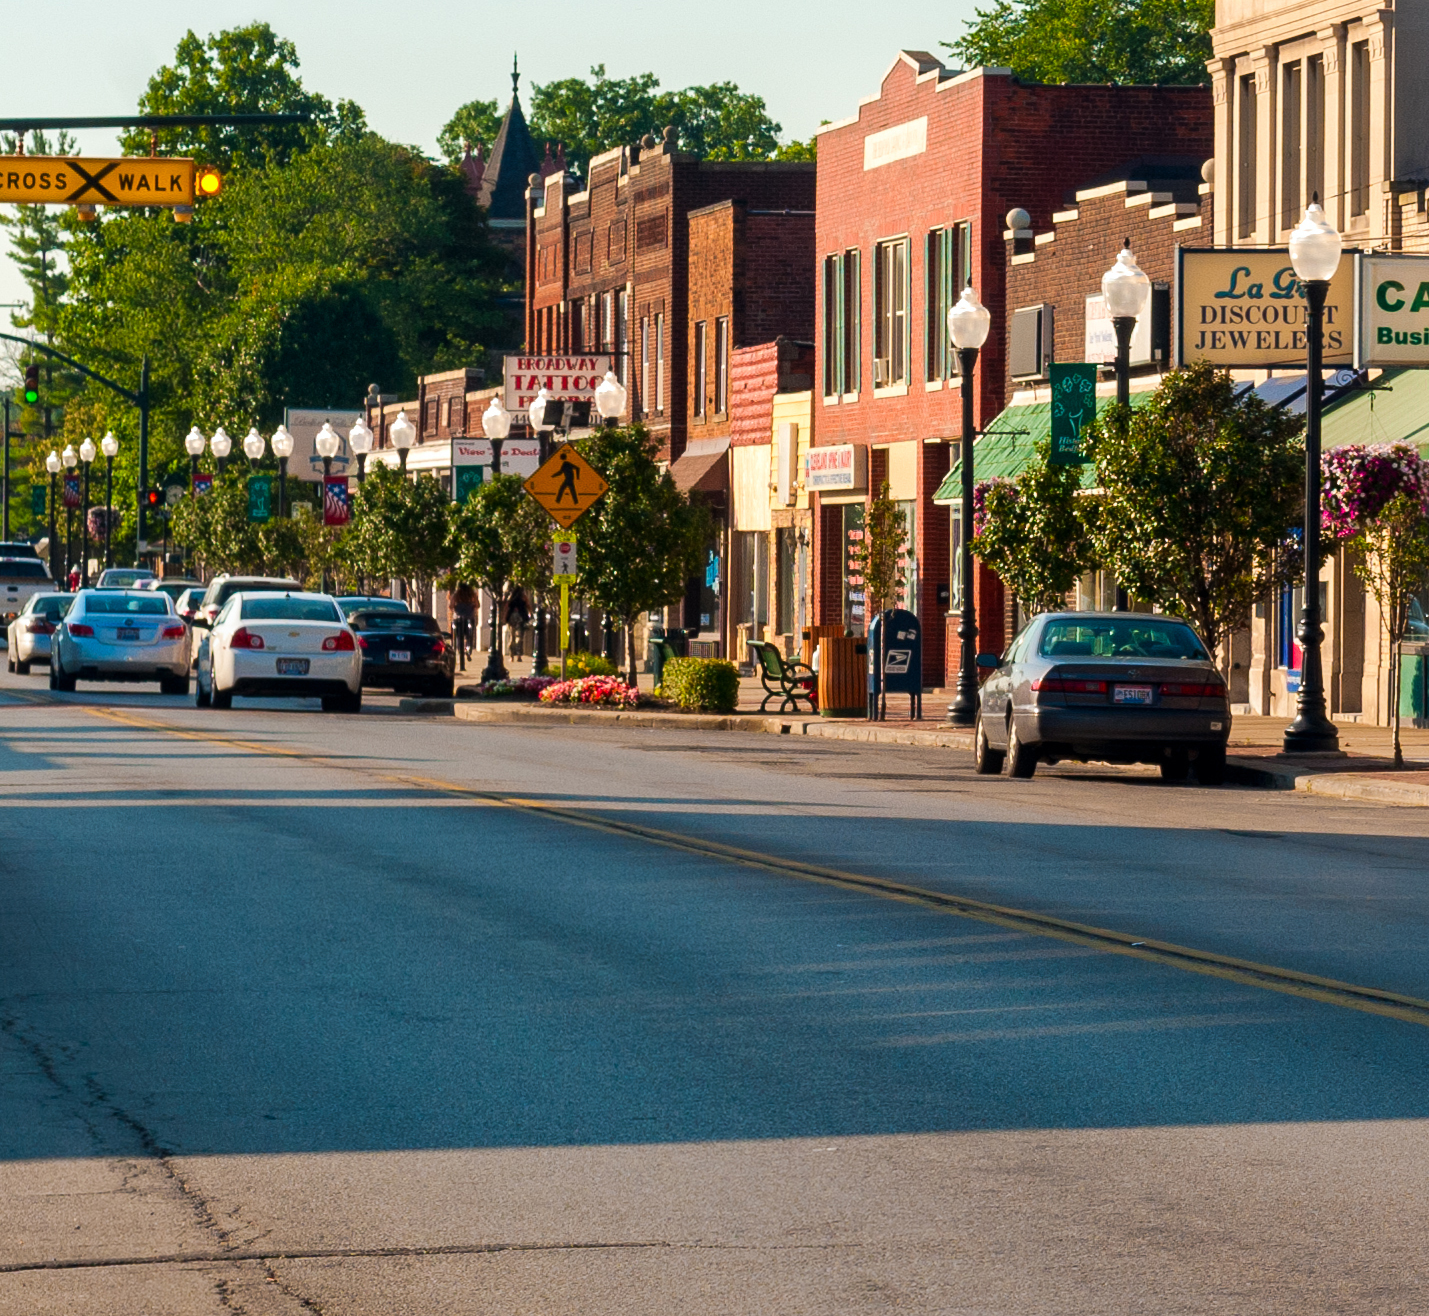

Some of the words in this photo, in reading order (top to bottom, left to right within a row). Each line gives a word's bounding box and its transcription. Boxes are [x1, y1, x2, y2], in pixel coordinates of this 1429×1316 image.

[0, 172, 67, 190] ROSS
[119, 173, 183, 192] WALK
[1214, 266, 1264, 300] La
[1195, 331, 1342, 349] JEWELES
[517, 358, 599, 370] BROADWAY
[458, 447, 485, 456] View
